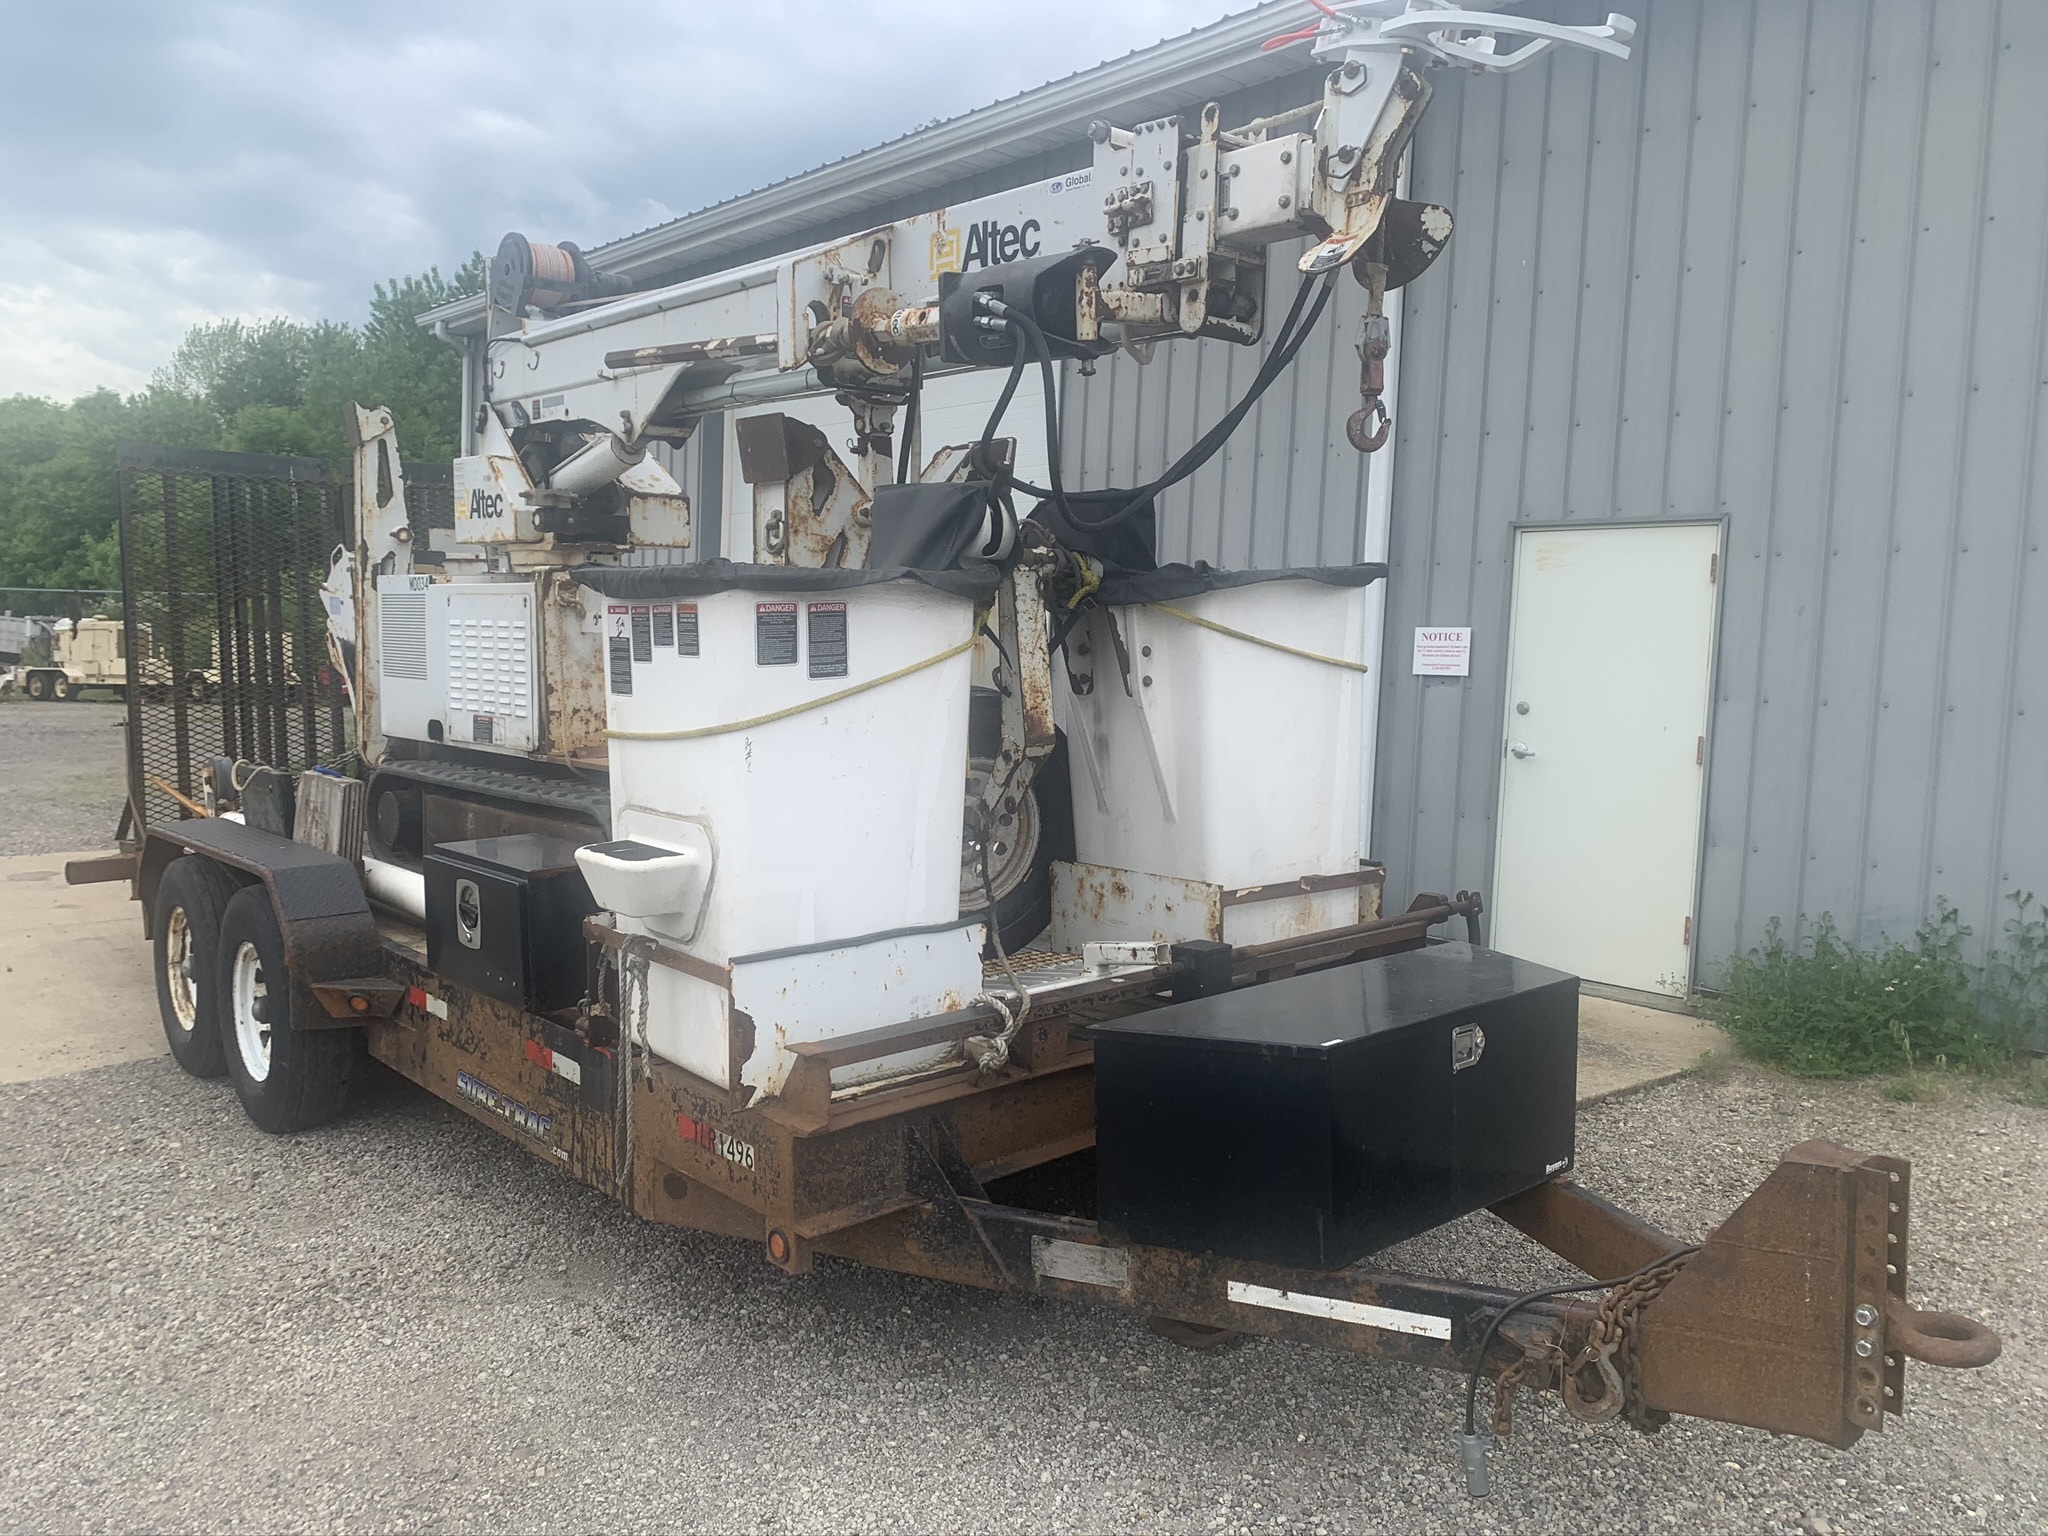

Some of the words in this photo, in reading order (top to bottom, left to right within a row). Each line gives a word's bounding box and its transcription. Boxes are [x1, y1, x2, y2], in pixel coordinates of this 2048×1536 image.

[1065, 172, 1091, 187] Global
[961, 218, 1041, 273] Altec
[470, 488, 503, 519] Altec
[765, 604, 795, 612] DANGER
[817, 603, 845, 612] DANGER
[1421, 632, 1463, 642] NOTICE
[456, 1069, 552, 1150] SURE-TRAC
